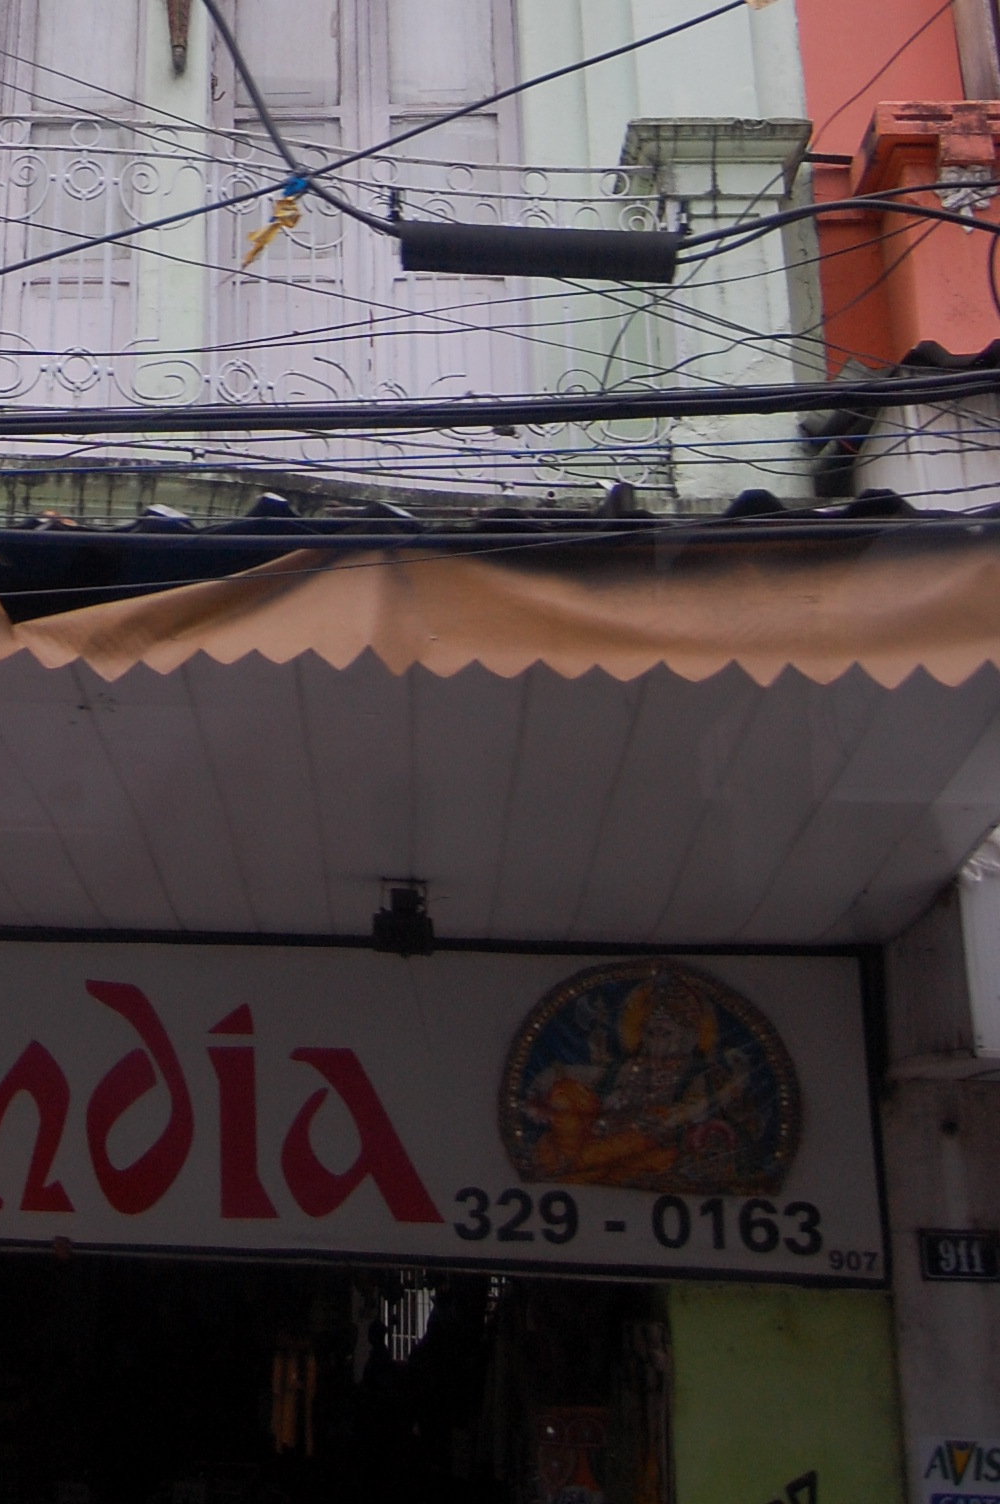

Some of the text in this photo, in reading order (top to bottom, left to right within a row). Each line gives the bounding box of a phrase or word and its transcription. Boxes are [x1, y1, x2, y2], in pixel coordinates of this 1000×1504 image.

[453, 1186, 580, 1246] 329
[651, 1194, 825, 1258] 0163
[828, 1248, 879, 1273] 907
[937, 1238, 985, 1274] 911
